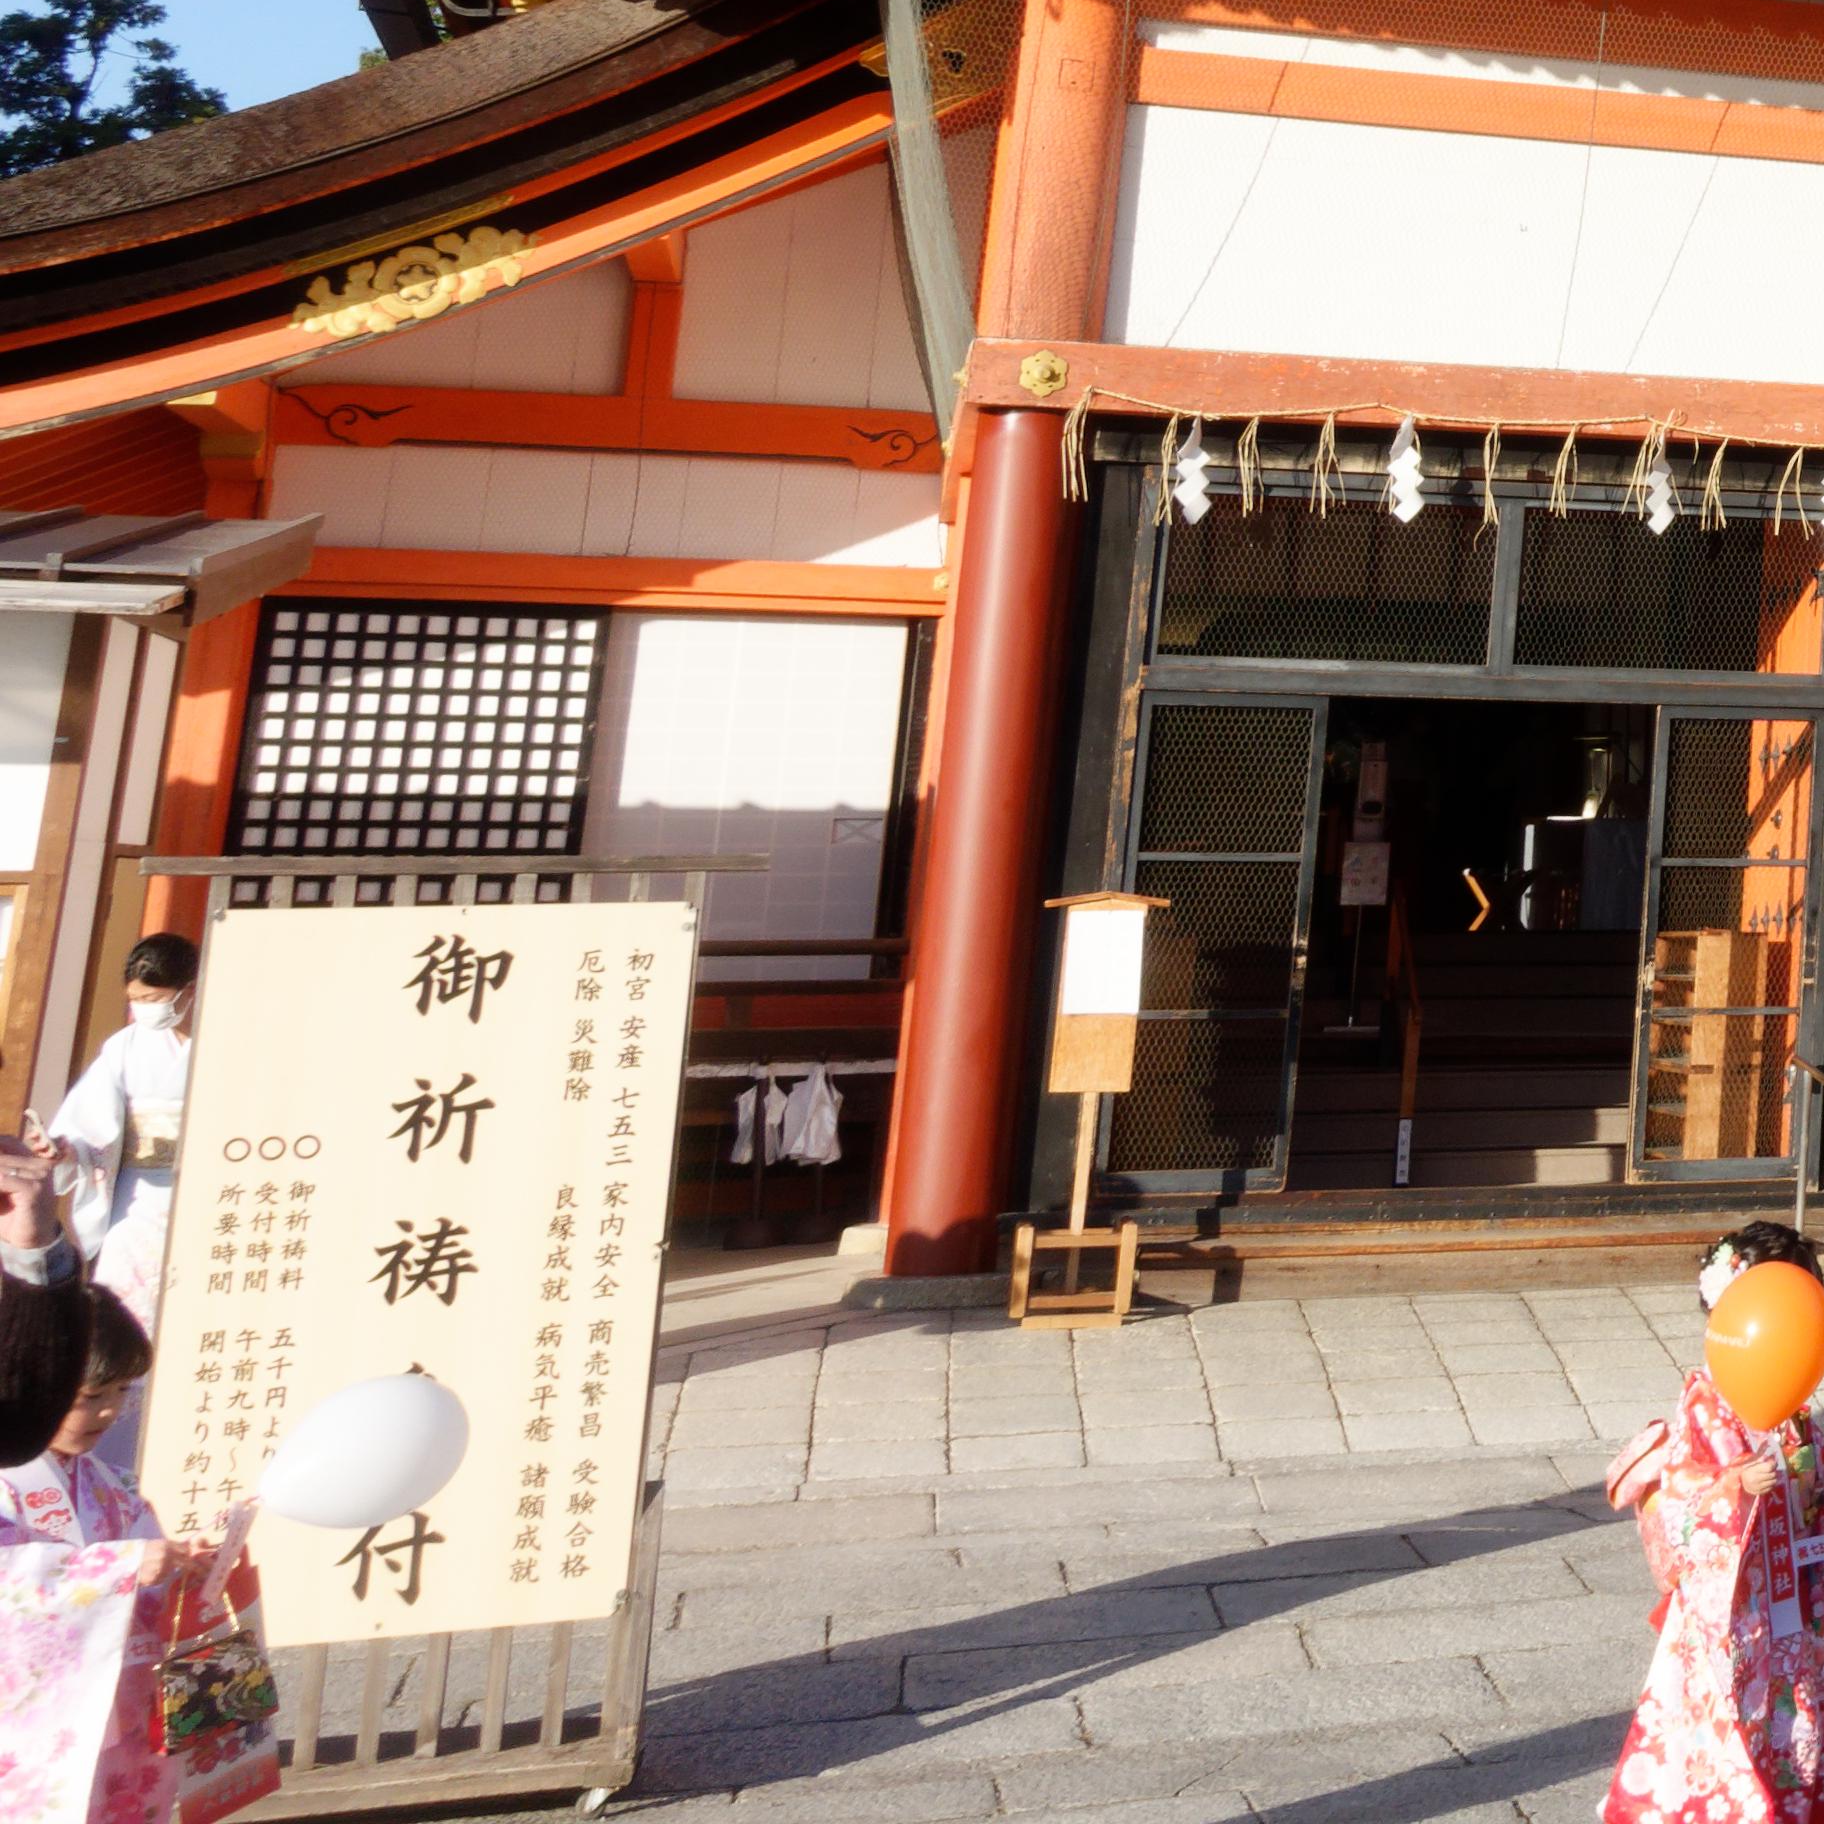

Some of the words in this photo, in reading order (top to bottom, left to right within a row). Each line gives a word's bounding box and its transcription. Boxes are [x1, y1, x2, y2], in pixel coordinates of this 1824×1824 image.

[574, 949, 606, 1002] 厄除
[625, 948, 656, 1001] 初宮
[563, 1017, 598, 1102] 災難除
[616, 1015, 647, 1069] 安産
[605, 1087, 640, 1166] 七五三
[207, 1183, 246, 1294] 所要時間
[242, 1181, 280, 1293] 受付時間
[277, 1180, 316, 1291] 御祈祷料
[333, 933, 515, 1606] 御祈祷付
[540, 1184, 579, 1303] 良縁成就
[590, 1181, 630, 1300] 家内安全
[523, 1321, 563, 1443] 病気平癒
[578, 1319, 615, 1438] 商売繁昌
[509, 1463, 550, 1585] 諸願成就
[559, 1458, 600, 1580] 受験合格
